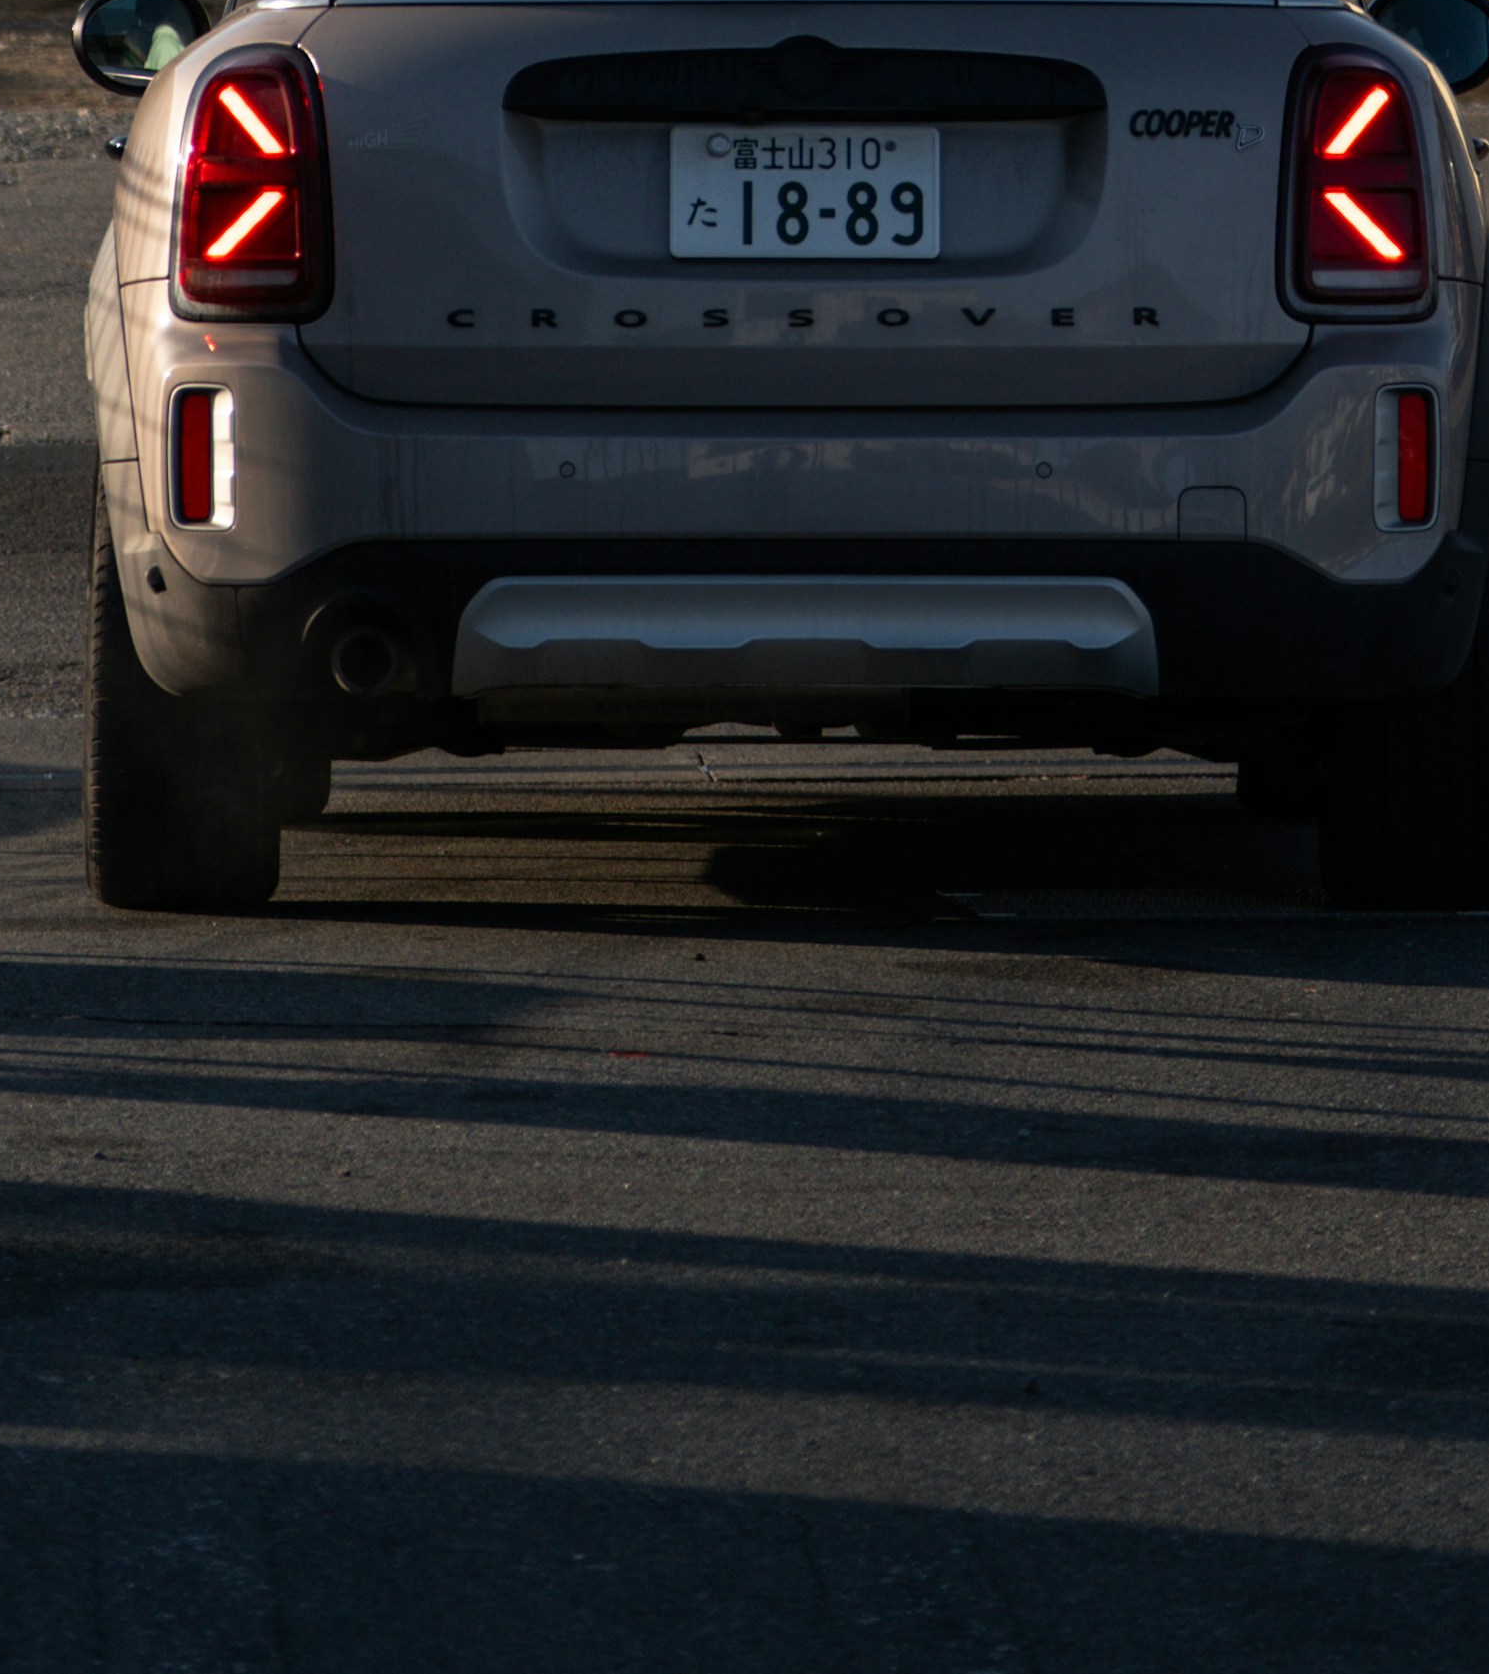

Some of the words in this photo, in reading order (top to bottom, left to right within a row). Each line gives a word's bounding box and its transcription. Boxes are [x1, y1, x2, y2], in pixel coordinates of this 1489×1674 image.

[1129, 108, 1235, 138] COOPER
[687, 197, 718, 228] た
[742, 180, 925, 247] 18-89
[445, 306, 1160, 330] CROSSOVER
